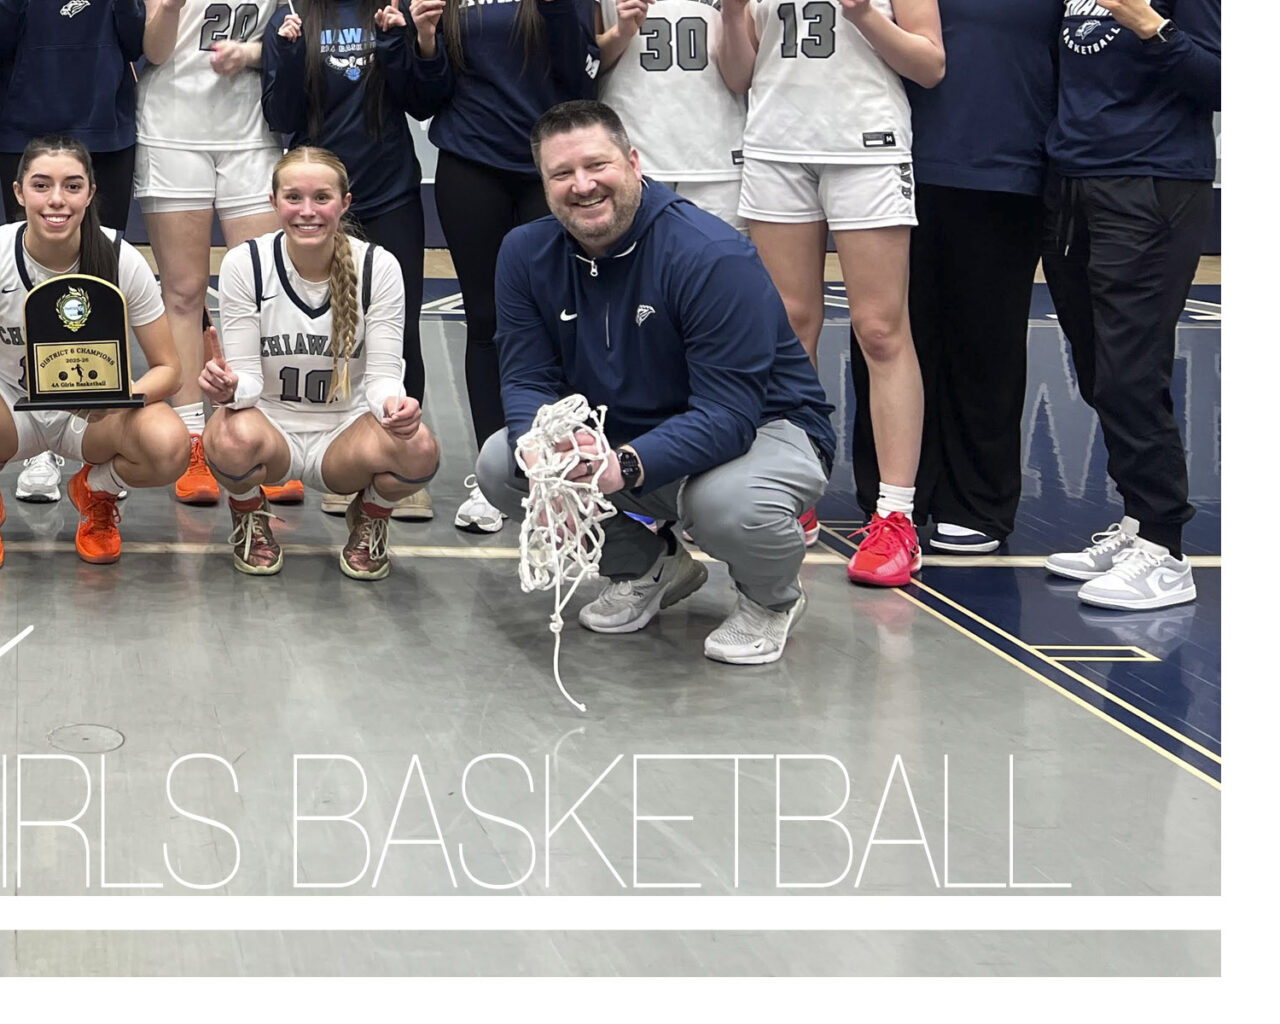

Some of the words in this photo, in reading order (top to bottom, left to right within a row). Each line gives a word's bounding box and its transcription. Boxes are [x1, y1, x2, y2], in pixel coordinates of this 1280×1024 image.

[199, 3, 260, 52] 20
[639, 17, 709, 72] 30
[777, 1, 836, 59] 13
[1063, 27, 1121, 55] BASKETBALL
[39, 349, 68, 369] DISTRICT
[76, 347, 115, 366] CHAMPIONS
[279, 366, 338, 404] 10
